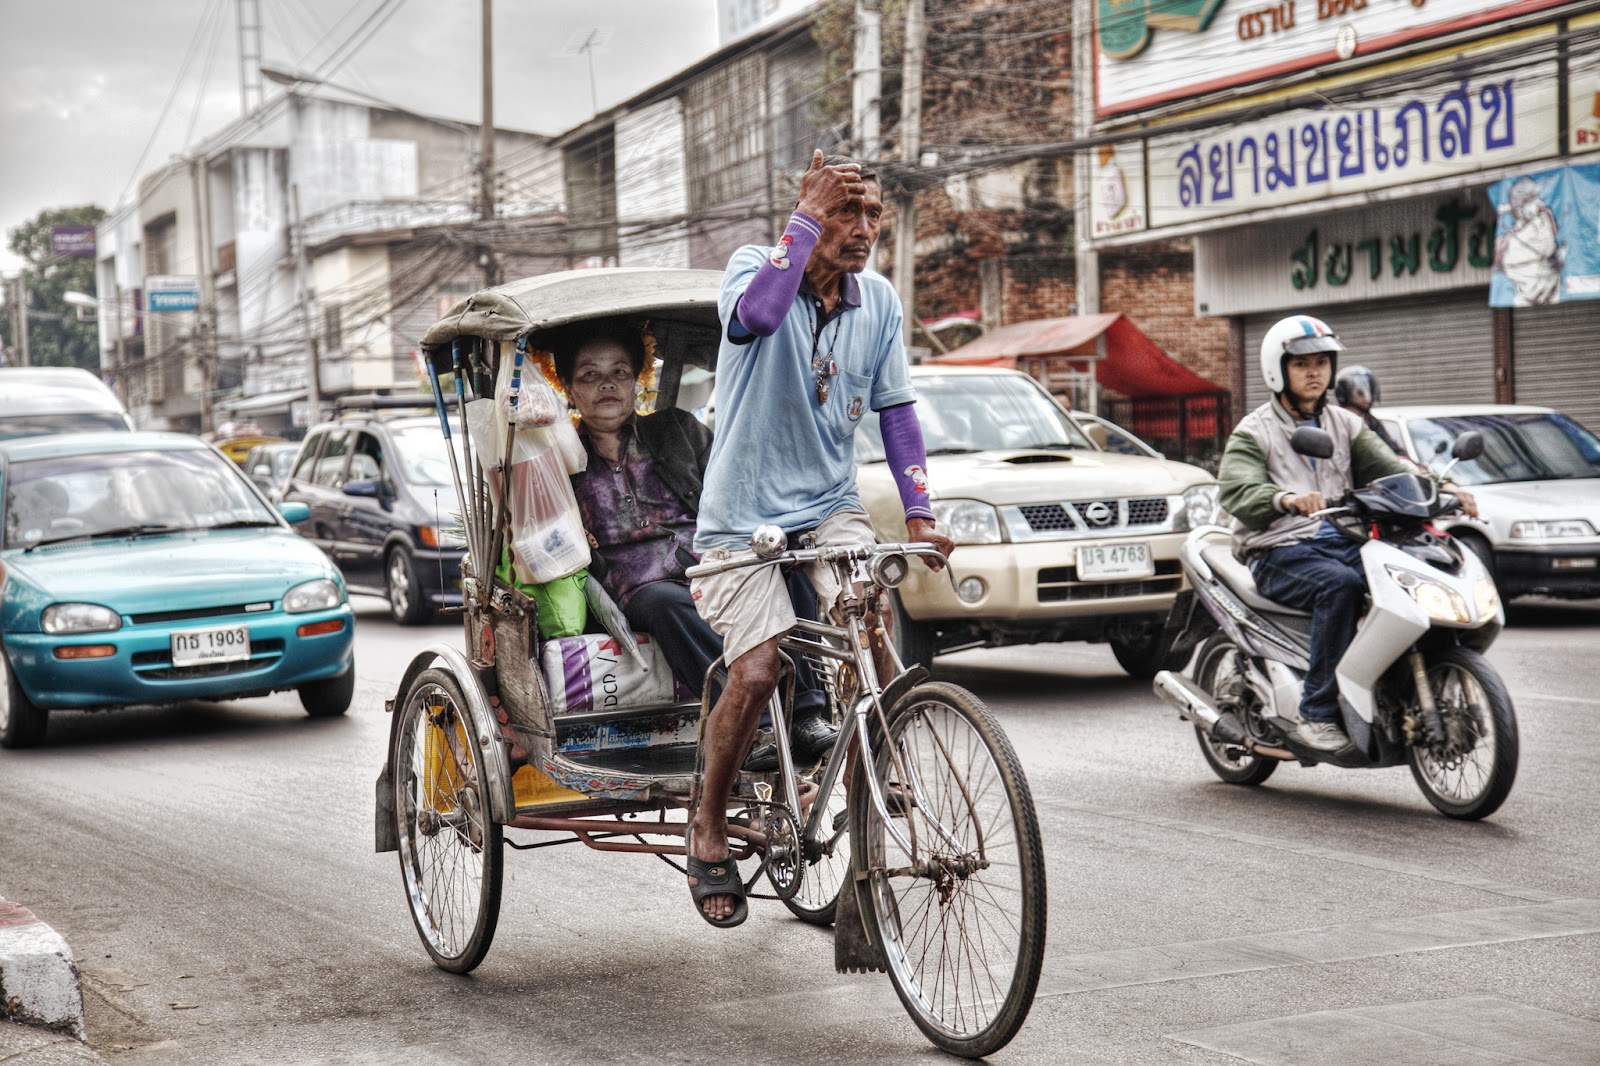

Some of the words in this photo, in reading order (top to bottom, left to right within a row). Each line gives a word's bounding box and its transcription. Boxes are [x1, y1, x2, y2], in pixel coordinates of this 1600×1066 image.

[1177, 54, 1515, 208] สยามชยเภสัช
[1110, 546, 1146, 563] 4763
[208, 629, 245, 648] 1903
